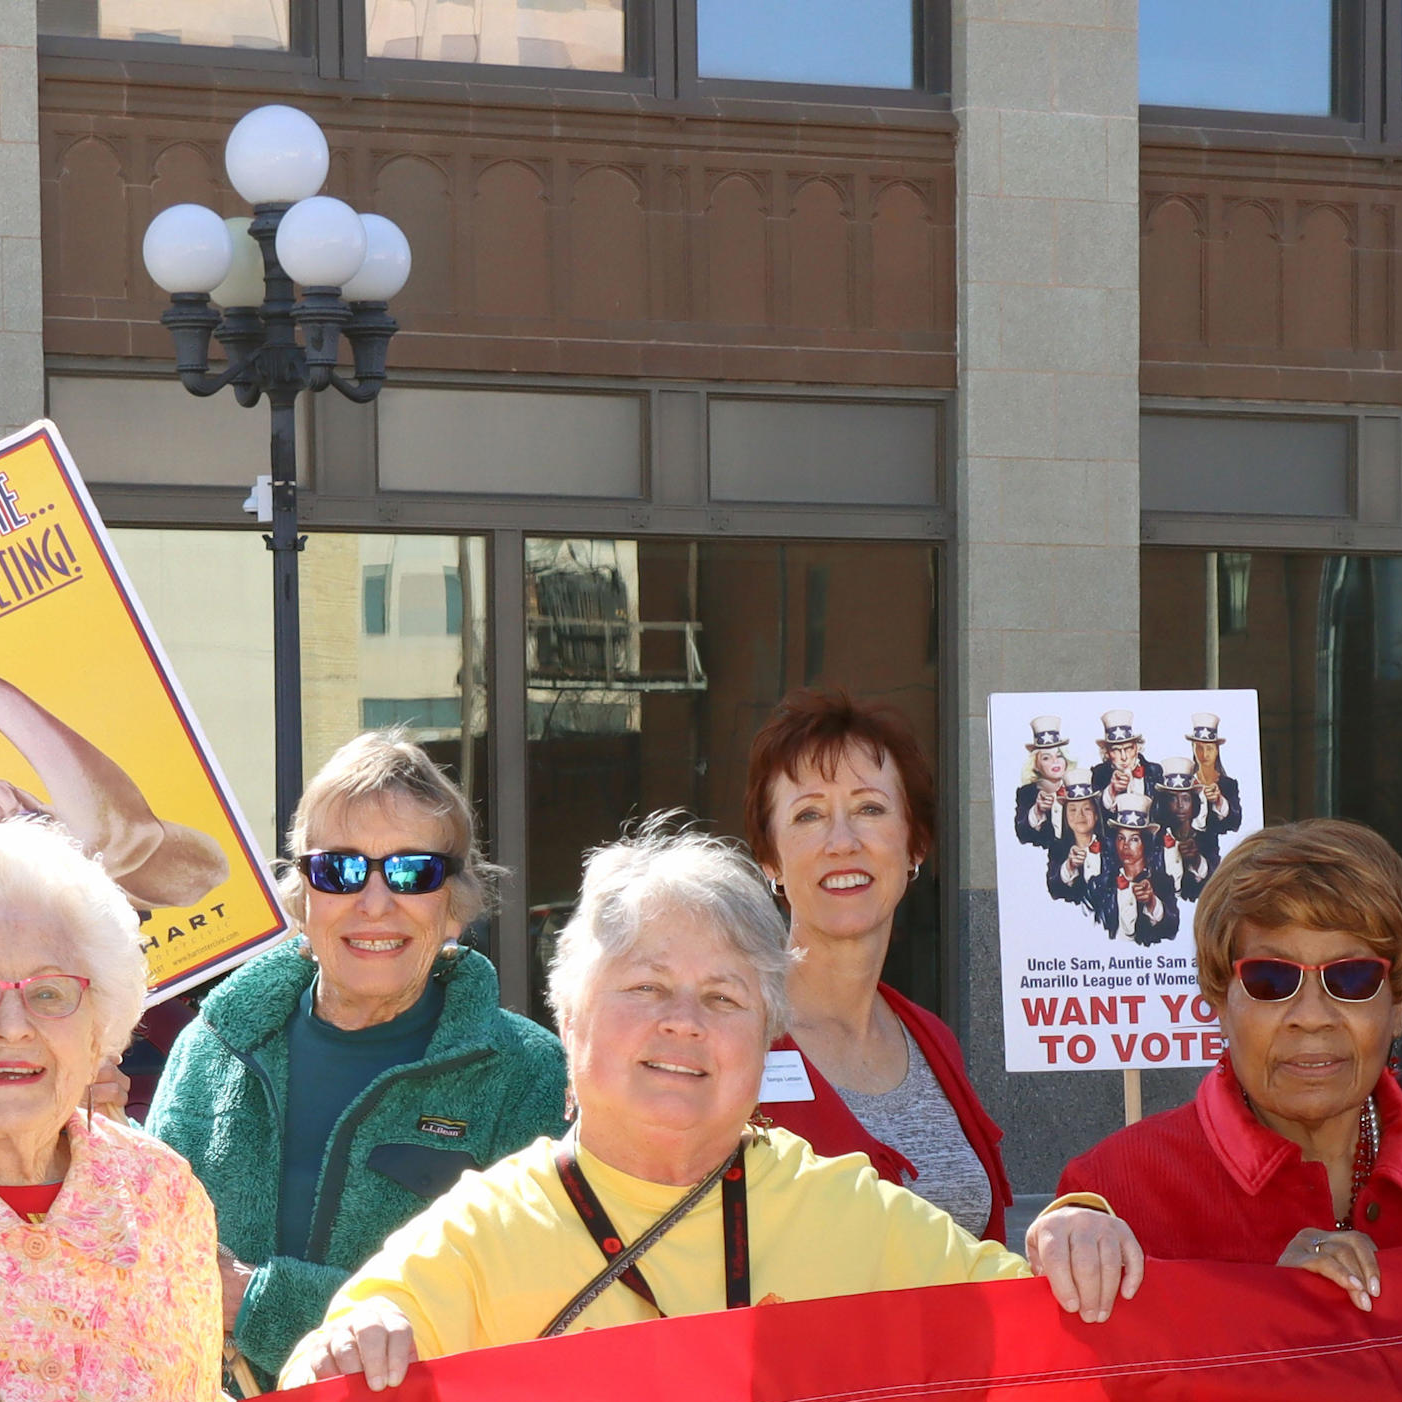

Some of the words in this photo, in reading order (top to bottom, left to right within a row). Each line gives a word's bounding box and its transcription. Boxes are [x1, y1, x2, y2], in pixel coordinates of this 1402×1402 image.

[139, 903, 225, 954] HART
[1028, 957, 1066, 972] Uncle
[1071, 956, 1105, 973] Sam,
[1109, 956, 1153, 970] Auntie
[1157, 955, 1187, 969] Sam
[1021, 974, 1079, 989] Amarillo
[1083, 973, 1133, 991] League
[1136, 972, 1150, 986] of
[1154, 972, 1199, 986] Wome
[1021, 994, 1146, 1027] WANT
[1160, 994, 1219, 1024] YO
[1039, 1034, 1097, 1064] TO
[1112, 1031, 1224, 1063] VOTE
